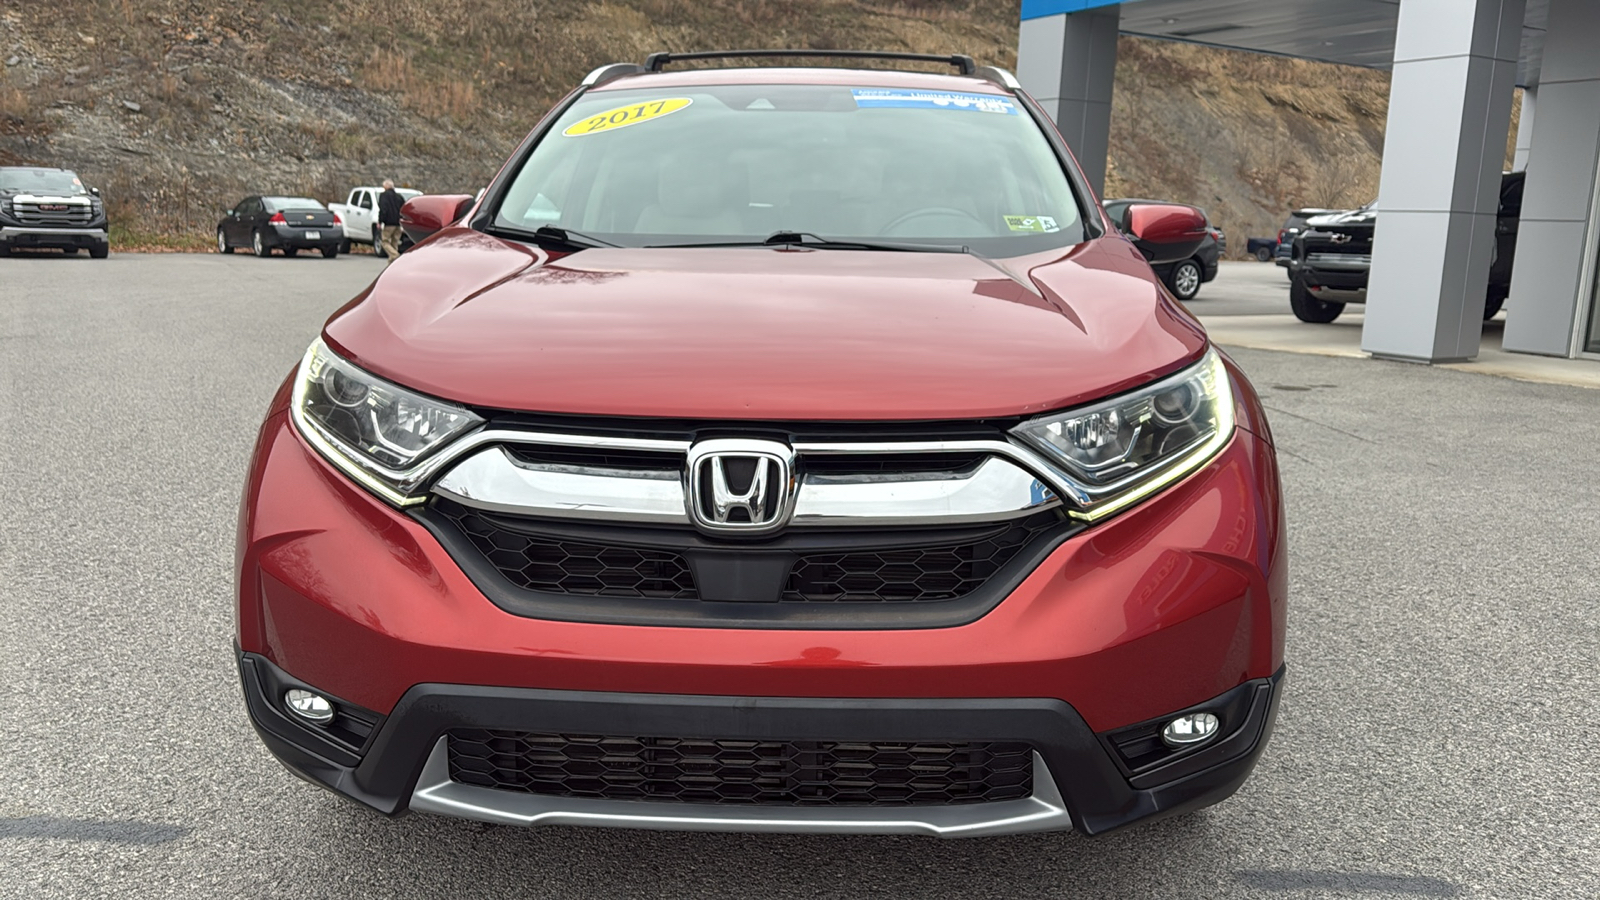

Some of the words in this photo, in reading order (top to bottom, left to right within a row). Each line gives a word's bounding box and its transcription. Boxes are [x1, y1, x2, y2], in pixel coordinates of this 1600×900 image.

[910, 92, 950, 100] Limited
[952, 94, 1003, 104] Warranty
[587, 100, 667, 132] 2017
